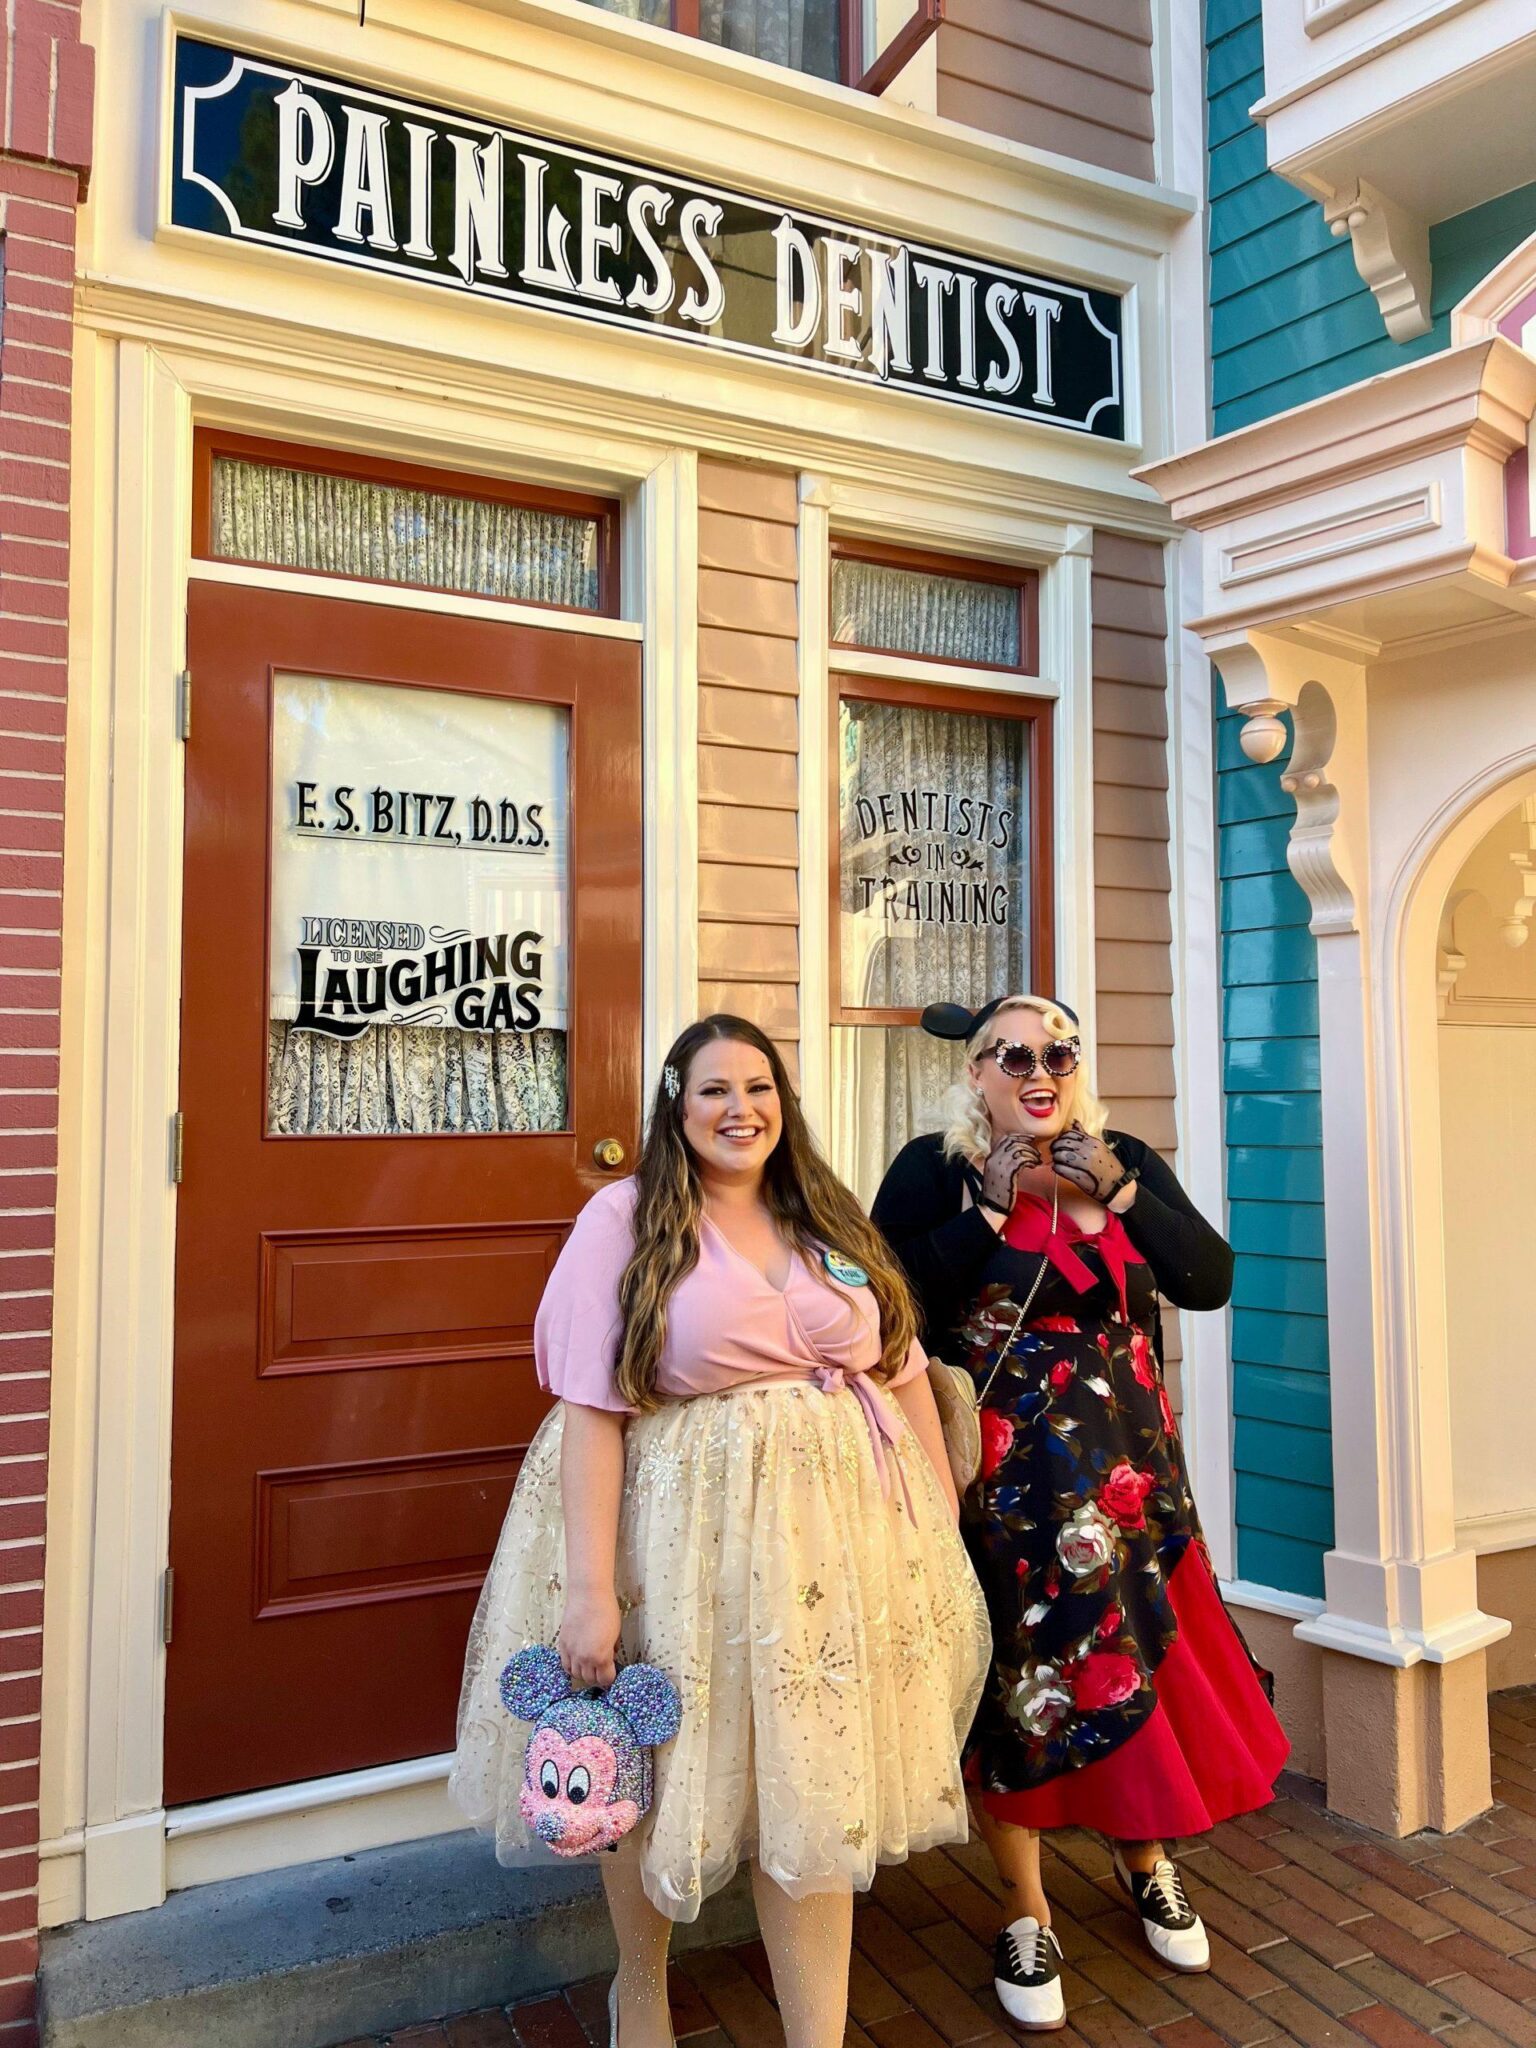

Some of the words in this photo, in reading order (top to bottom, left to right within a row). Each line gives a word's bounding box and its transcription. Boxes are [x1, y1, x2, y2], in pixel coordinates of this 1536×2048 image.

[271, 78, 725, 327] PAINLESS
[771, 213, 1062, 406] DENTIST
[370, 786, 463, 846] BITZ,
[471, 795, 550, 848] D.D.S.
[855, 788, 1013, 849] DENTISTS
[926, 843, 946, 874] IN
[858, 875, 1009, 929] TRAINING
[301, 916, 426, 951] LICENSED
[331, 949, 350, 963] TO
[354, 950, 383, 964] USE
[290, 930, 545, 1040] LAUGHING
[454, 982, 543, 1033] GAS
